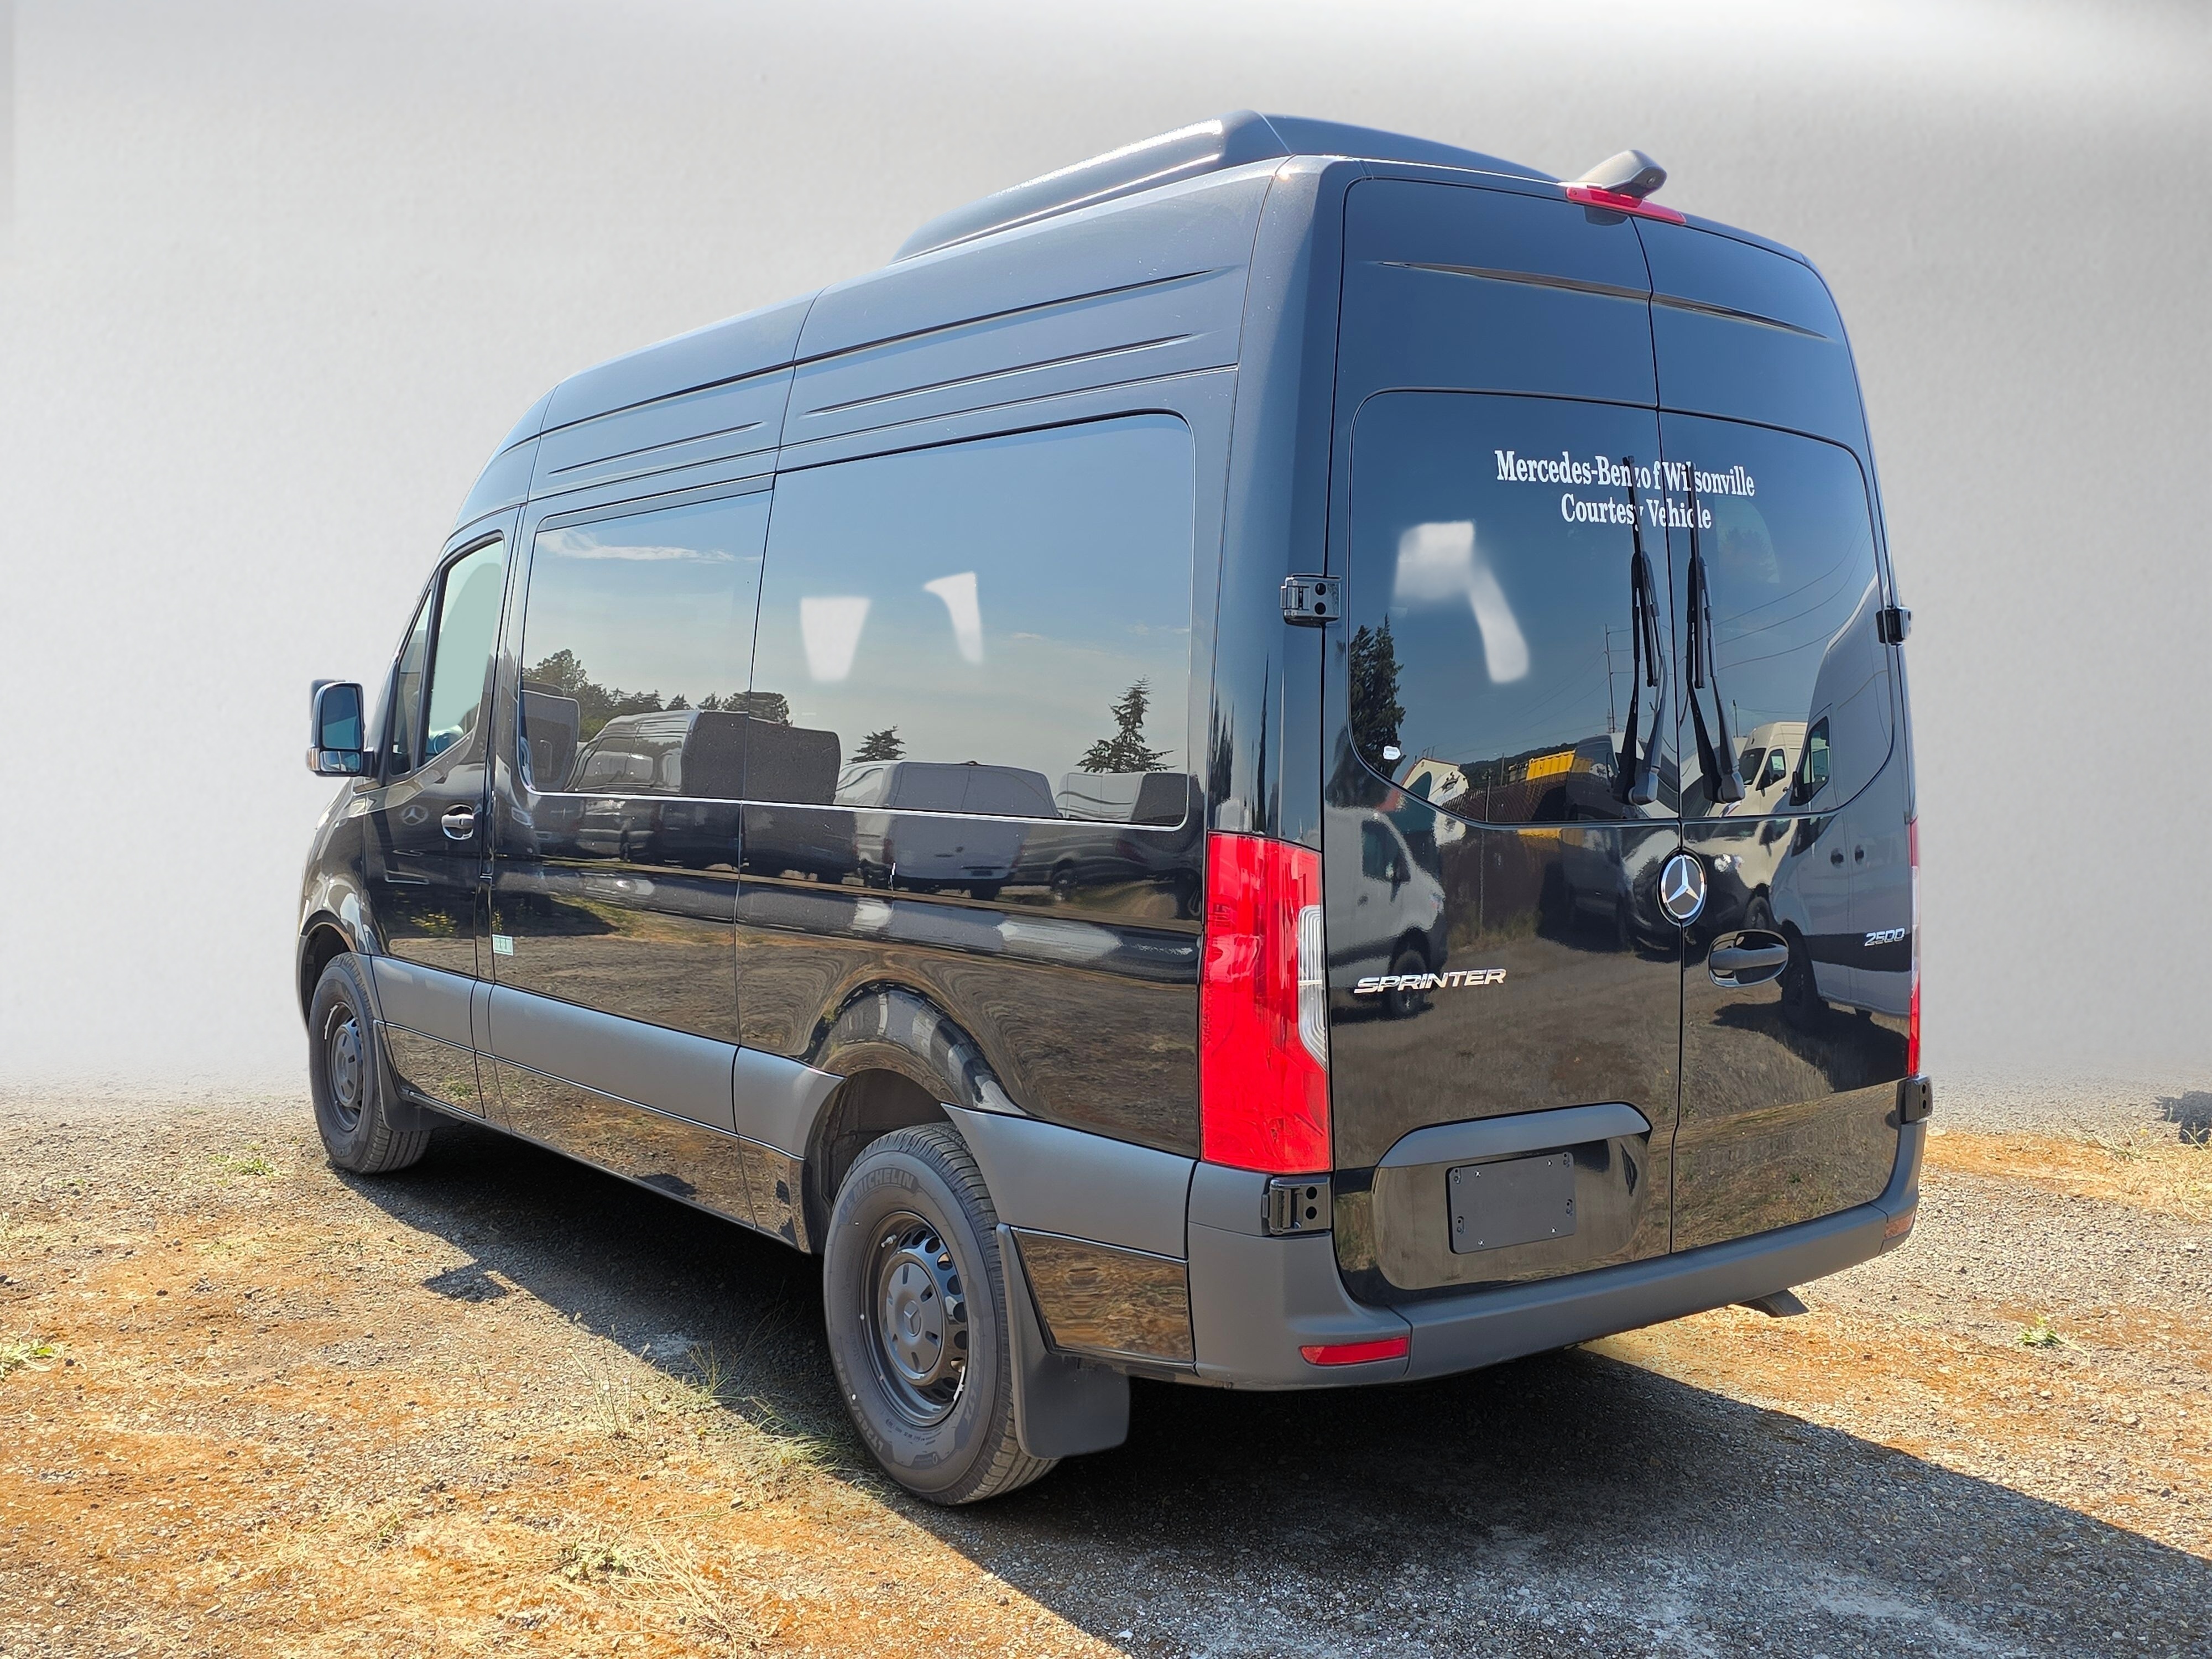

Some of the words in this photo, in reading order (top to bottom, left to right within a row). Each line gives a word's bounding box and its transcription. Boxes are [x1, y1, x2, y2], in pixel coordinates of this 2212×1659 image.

[1641, 460, 1661, 490] of
[1864, 928, 1905, 946] 2500
[1354, 968, 1506, 993] SPRINTER
[852, 1168, 915, 1203] MICHELIN
